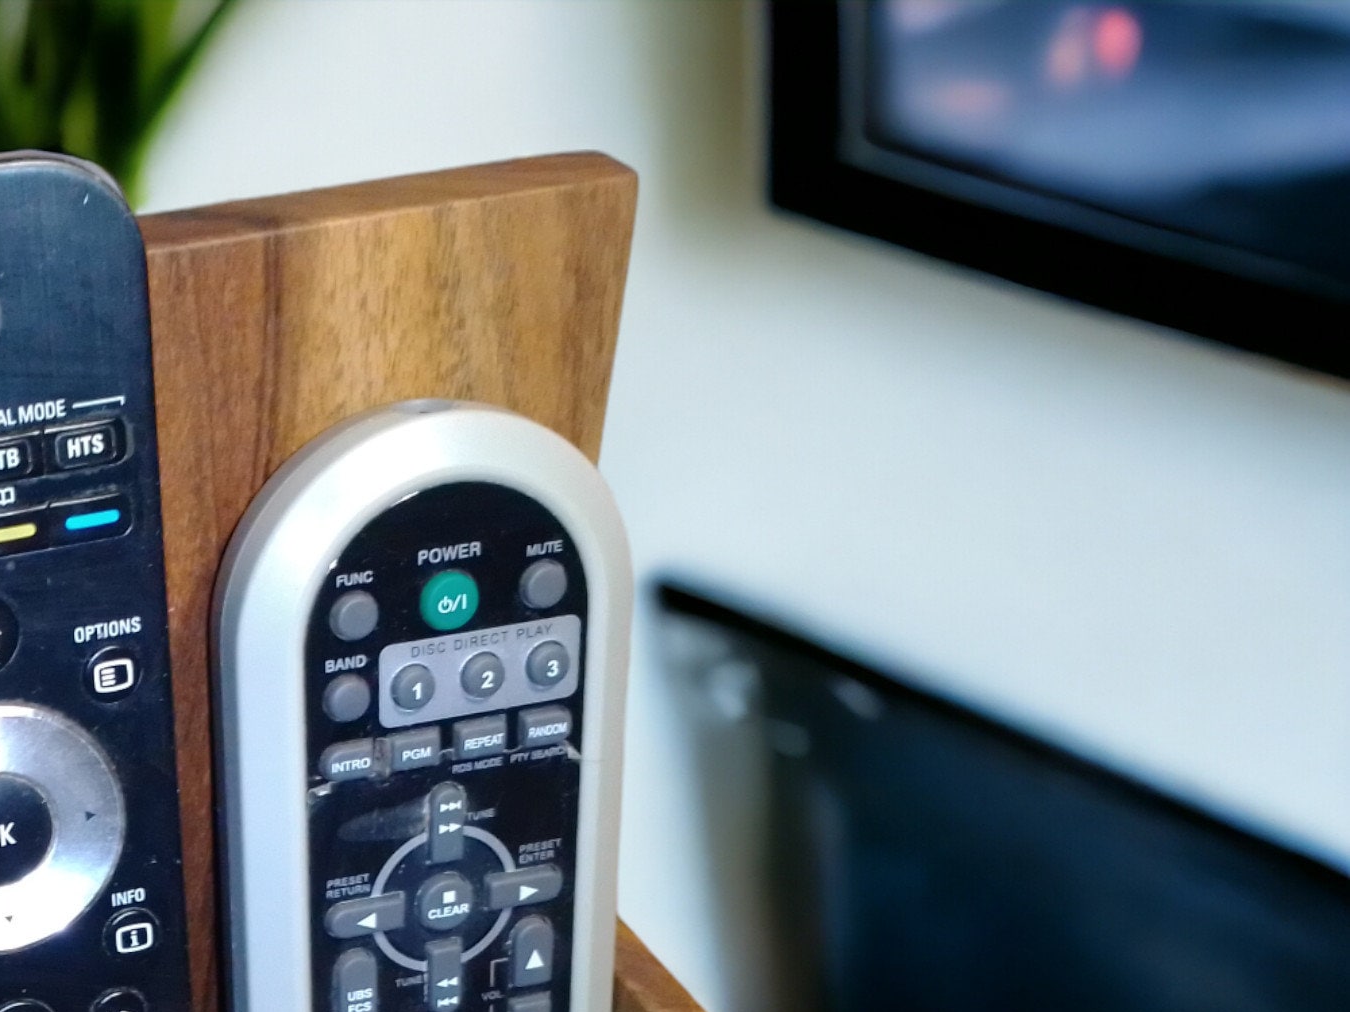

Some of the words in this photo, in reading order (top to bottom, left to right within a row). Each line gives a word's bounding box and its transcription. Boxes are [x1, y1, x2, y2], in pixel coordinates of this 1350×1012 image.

[18, 399, 66, 427] MODE
[67, 433, 105, 458] HTS
[417, 541, 482, 566] POWER
[526, 540, 563, 557] MUTE
[336, 570, 374, 588] FUNC
[73, 616, 142, 644] OPTIONS
[411, 643, 446, 658] DISC
[454, 631, 508, 651] DIRECT
[516, 624, 553, 639] PLAY
[324, 655, 367, 674] BAND
[547, 660, 559, 678] 3
[481, 671, 494, 689] 2
[412, 683, 422, 700] 1
[528, 722, 568, 738] RANDOM
[464, 733, 505, 751] REPEAT
[402, 747, 432, 762] PGM
[331, 757, 371, 774] INTRO
[519, 838, 562, 853] PRESET
[519, 849, 555, 865] ENTER
[326, 873, 370, 889] PRESET
[111, 887, 146, 907] INFO
[428, 903, 470, 919] CLEAR
[347, 988, 373, 1002] UBS
